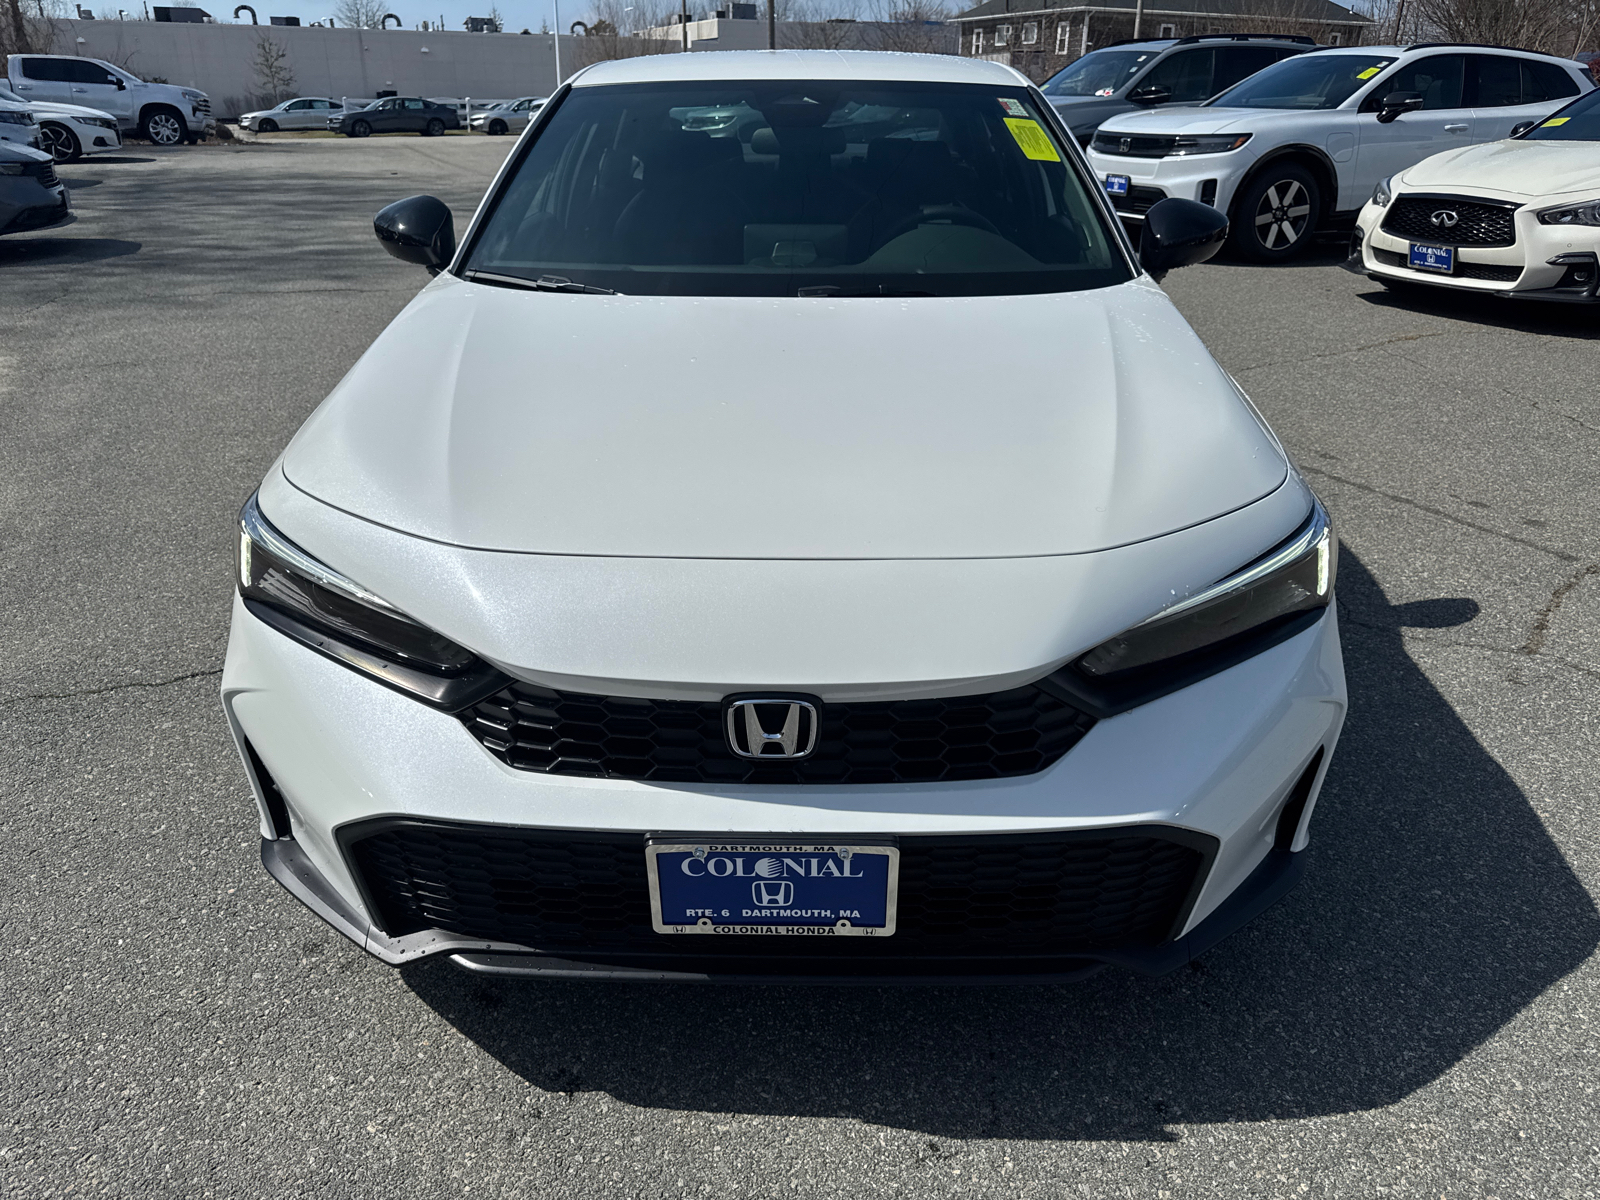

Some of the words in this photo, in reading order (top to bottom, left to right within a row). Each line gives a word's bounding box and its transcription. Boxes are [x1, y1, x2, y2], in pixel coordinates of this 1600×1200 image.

[686, 909, 717, 917] RTE.
[721, 909, 730, 917] 6
[742, 909, 835, 919] DARTMOUTH,
[839, 910, 861, 918] MA
[713, 926, 782, 934] COLONIAL
[786, 927, 836, 935] HONDA
